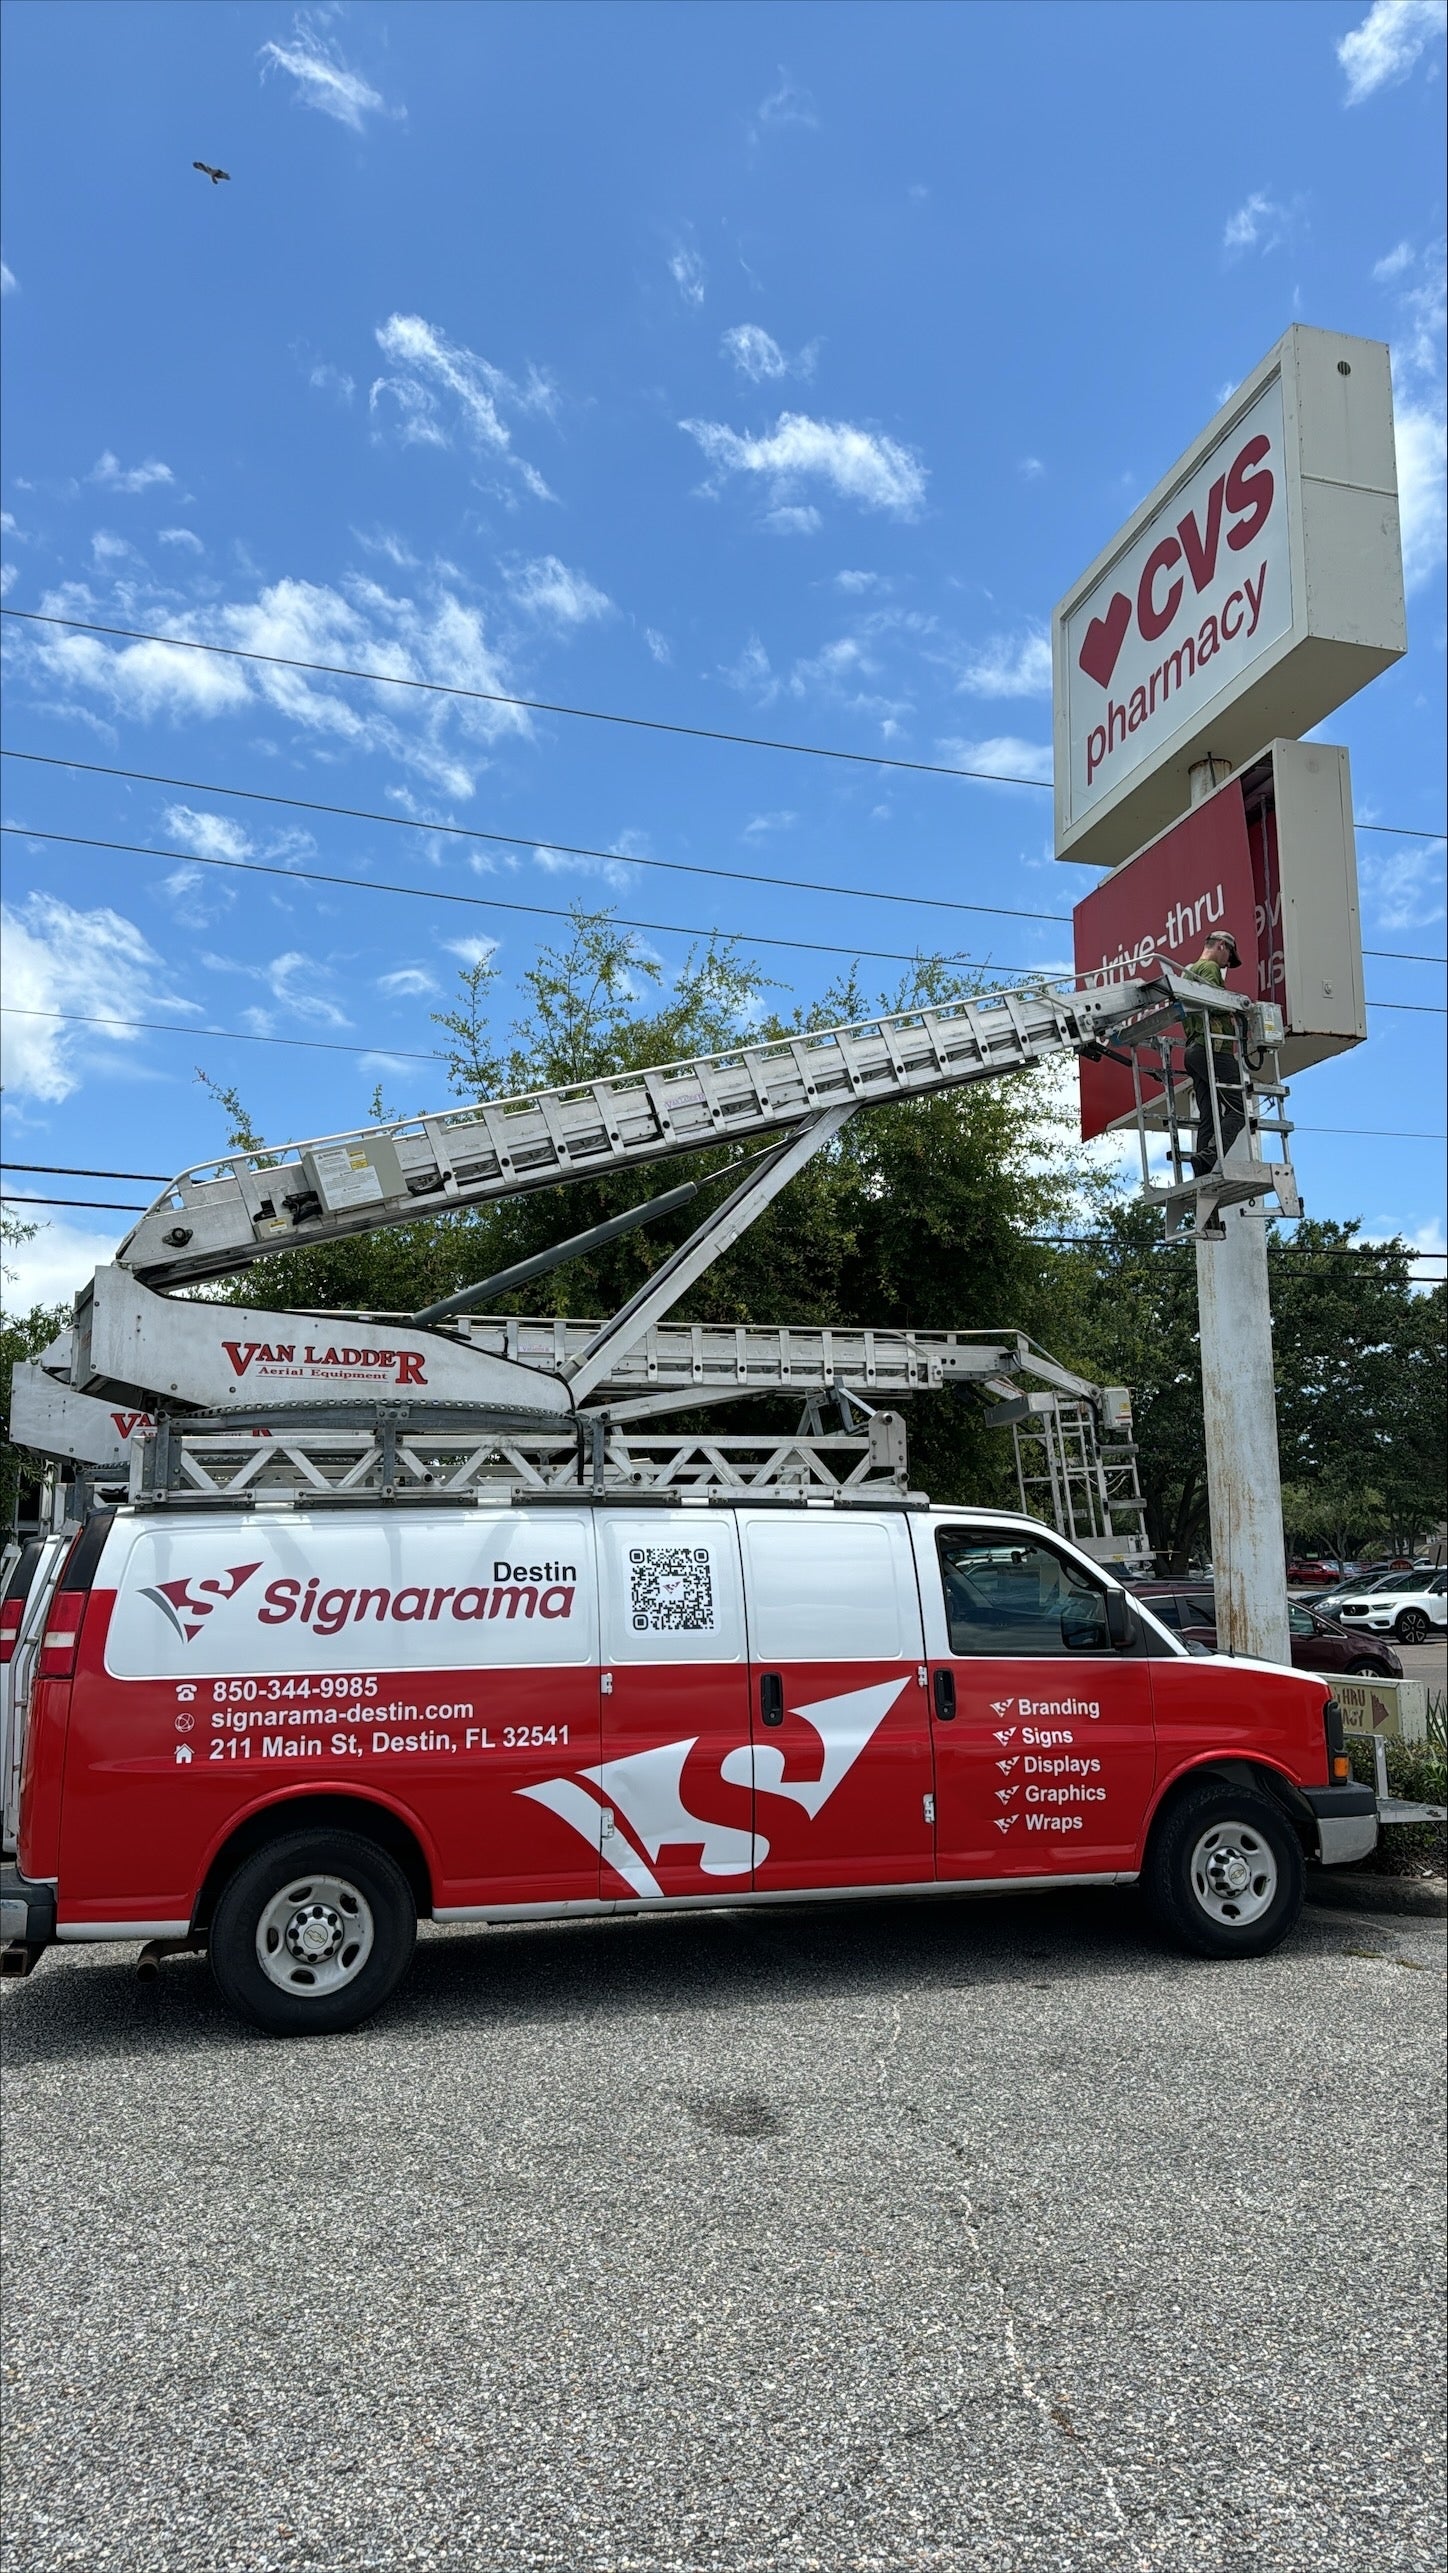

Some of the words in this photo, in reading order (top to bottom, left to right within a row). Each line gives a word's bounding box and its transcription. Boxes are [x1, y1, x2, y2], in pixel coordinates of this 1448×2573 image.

[1136, 434, 1275, 642] CVS
[1086, 559, 1268, 787] pharmacy
[1094, 883, 1225, 988] drive-thru
[221, 1341, 297, 1377] VAN
[303, 1345, 429, 1385] LADDER
[258, 1365, 304, 1377] Aerial
[310, 1368, 388, 1381] Equipment
[110, 1413, 158, 1440] VA
[493, 1560, 577, 1582] Destin
[258, 1577, 576, 1636] Signarama
[212, 1676, 379, 1702] 850-344-9985
[210, 1702, 475, 1732] signarama-destin.com
[1018, 1697, 1100, 1719] Branding
[209, 1737, 251, 1760] 211
[262, 1734, 322, 1758] Main
[330, 1733, 363, 1758] St,
[372, 1729, 458, 1754] Destin,
[465, 1727, 496, 1749] FL
[502, 1724, 570, 1748] 32541
[1021, 1727, 1074, 1749] Signs
[1024, 1755, 1101, 1777] Displays
[1025, 1784, 1107, 1806] Graphics
[1025, 1813, 1083, 1834] Wraps
